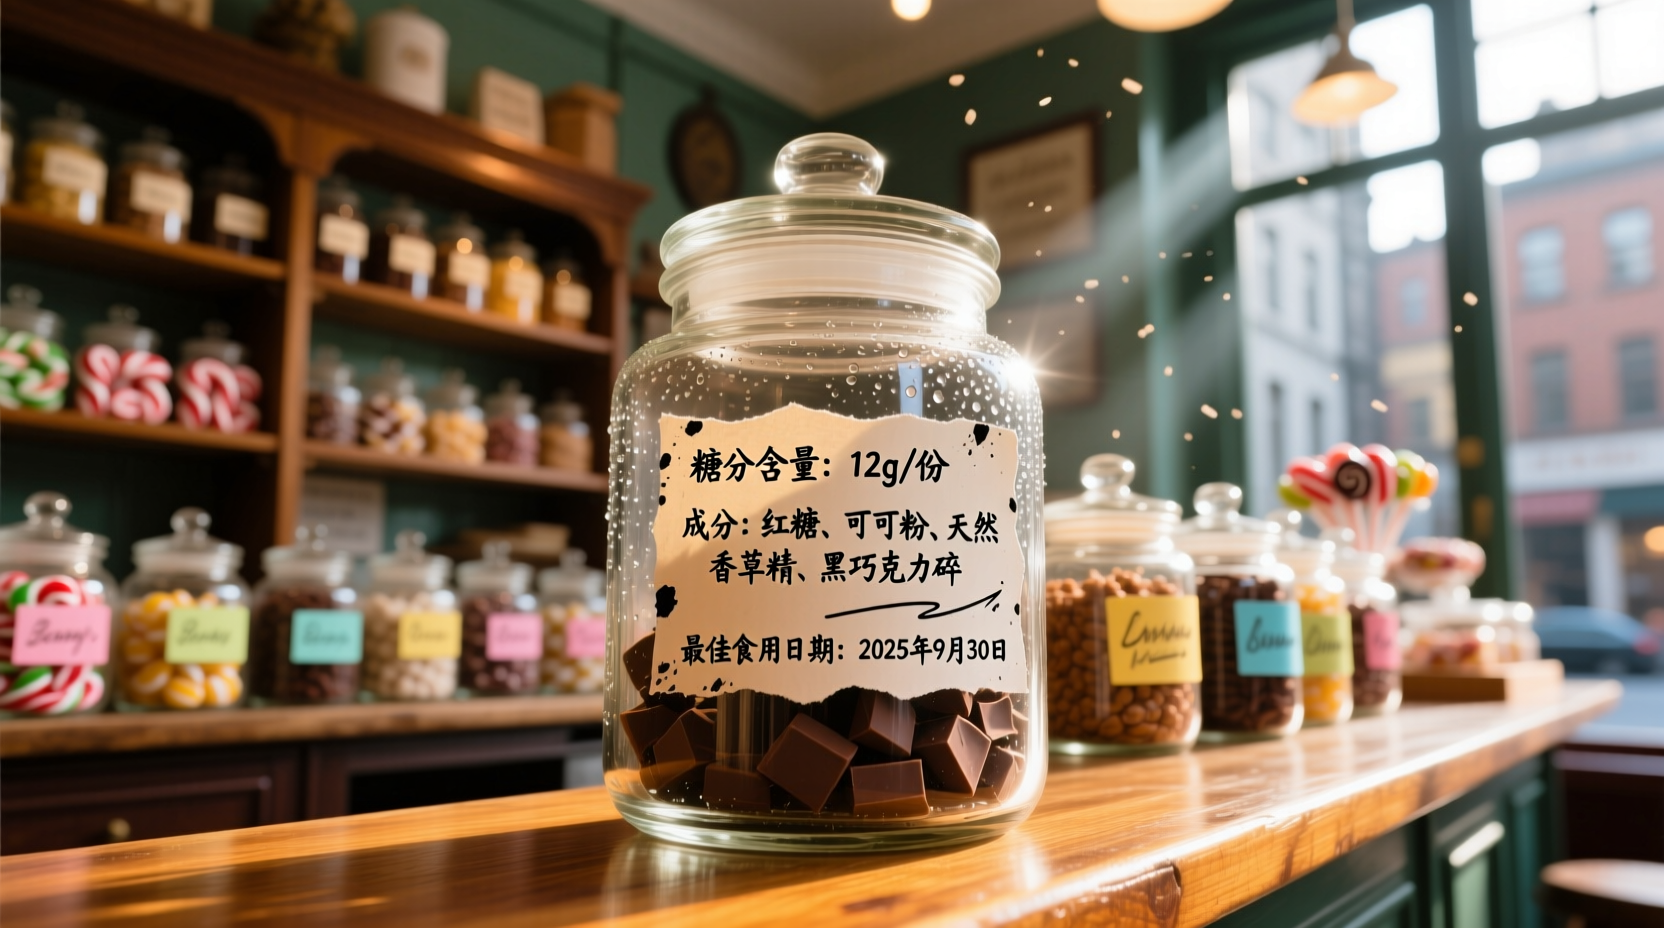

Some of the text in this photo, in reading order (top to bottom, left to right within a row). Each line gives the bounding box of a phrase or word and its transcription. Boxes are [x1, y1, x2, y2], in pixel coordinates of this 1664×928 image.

[708, 548, 963, 587] 香草精、黑巧克力碎
